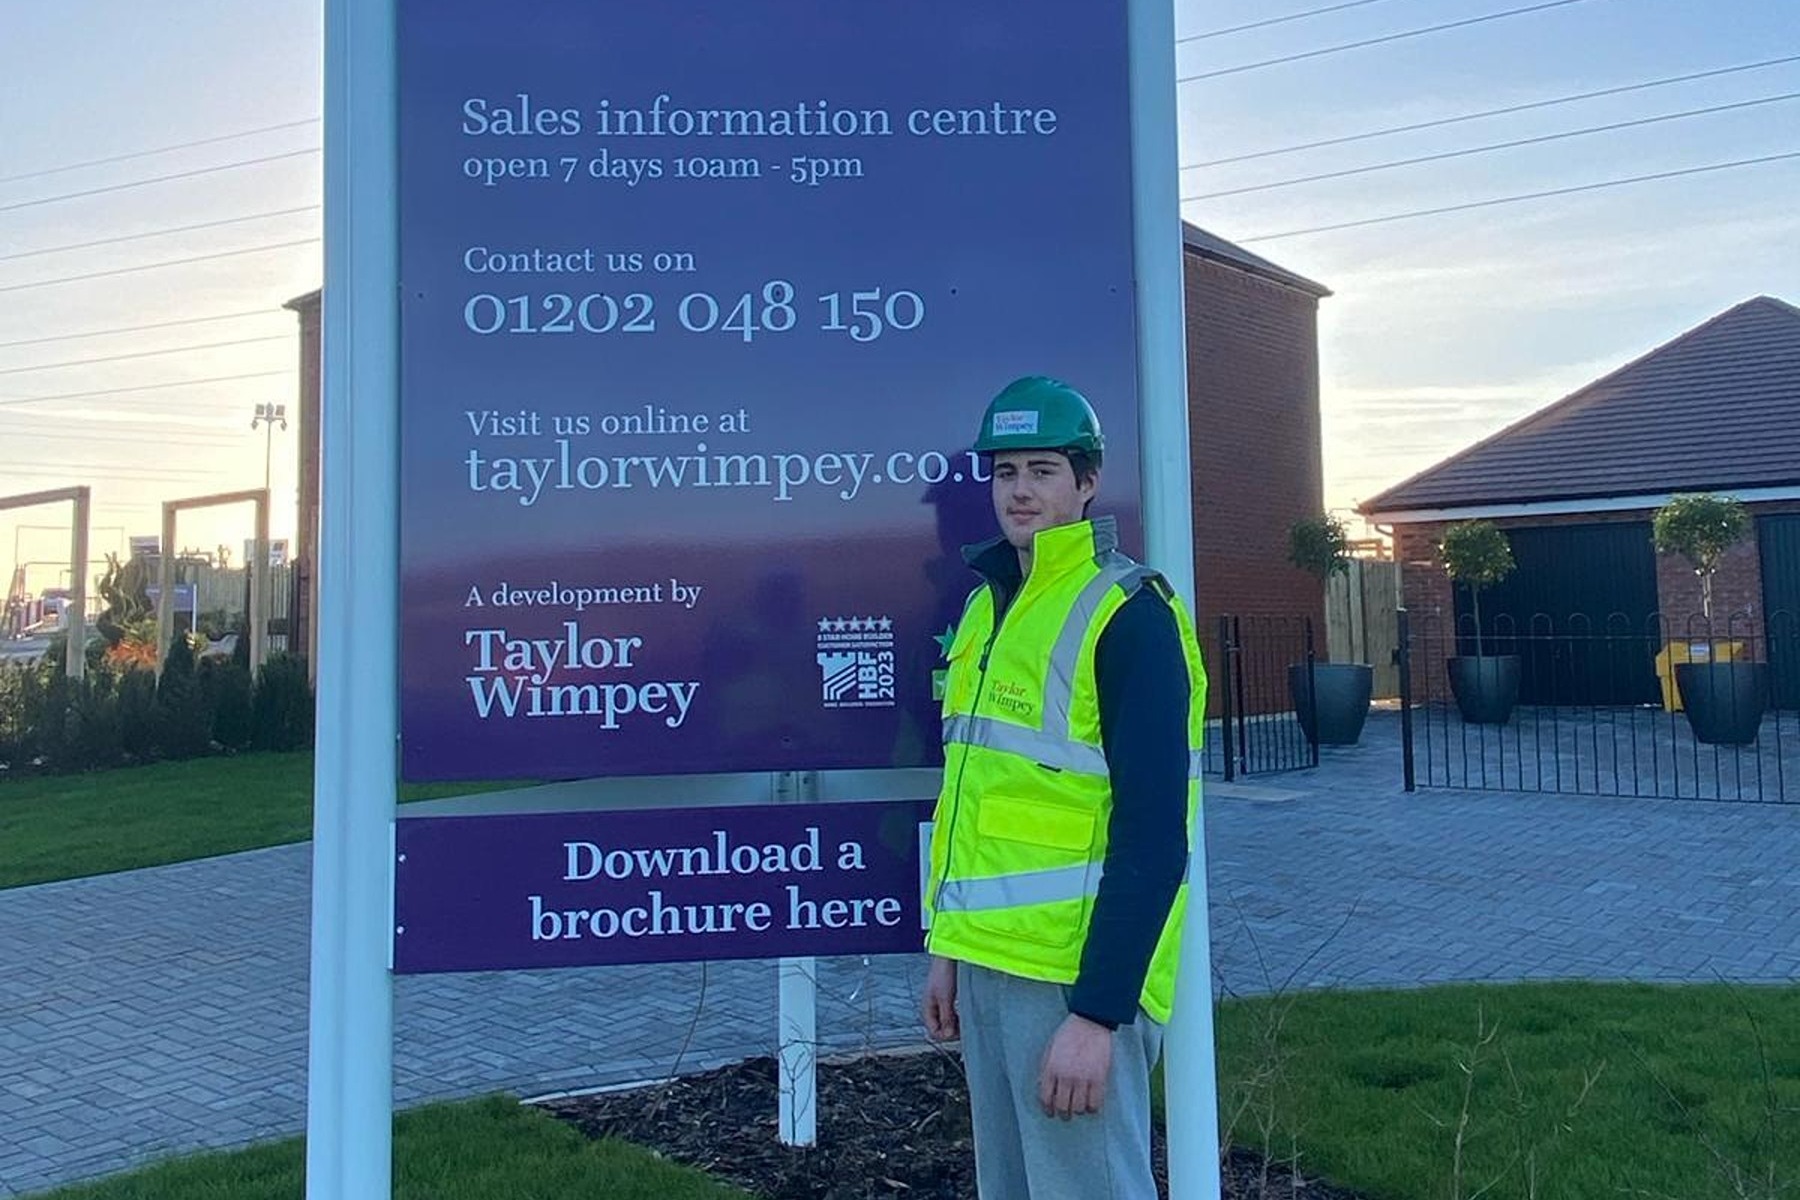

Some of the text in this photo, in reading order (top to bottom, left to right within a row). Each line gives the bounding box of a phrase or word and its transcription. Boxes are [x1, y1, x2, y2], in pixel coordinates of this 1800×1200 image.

[462, 94, 1057, 136] Sales information centre
[462, 157, 550, 186] open
[559, 157, 578, 182] 7
[588, 148, 662, 187] days
[673, 157, 762, 181] 10am
[790, 156, 865, 186] 5pm
[463, 247, 697, 273] Contact us on
[463, 280, 925, 343] 01202 048 150
[465, 405, 751, 437] Visit us online at
[465, 439, 992, 506] taylorwimpey.co.u
[465, 578, 703, 612] A development by
[465, 621, 643, 685] Taylor
[857, 651, 878, 700] HBF
[877, 650, 895, 699] 2023
[465, 675, 700, 730] Wimpey
[562, 826, 867, 881] Download a
[527, 884, 902, 941] brochure here
